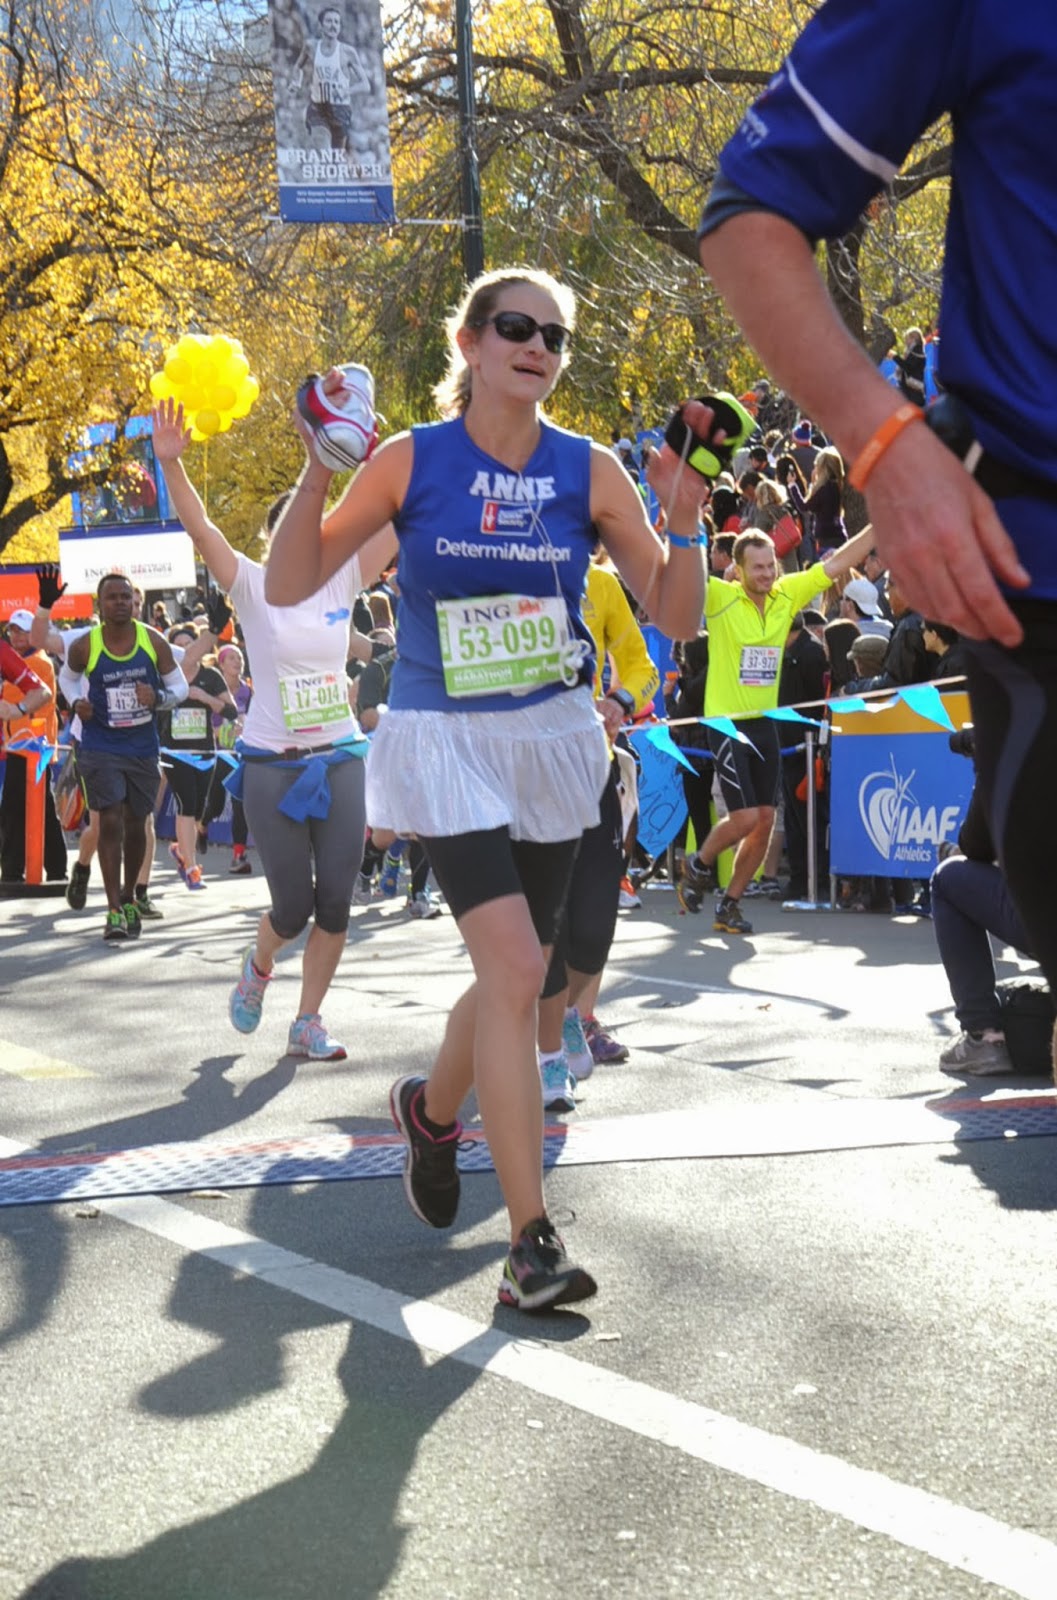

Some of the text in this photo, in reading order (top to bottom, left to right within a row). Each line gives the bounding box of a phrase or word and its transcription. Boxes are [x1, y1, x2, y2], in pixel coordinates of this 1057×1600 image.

[286, 148, 347, 163] FRANK
[302, 163, 383, 179] SHORTER
[469, 470, 556, 502] ANNE
[436, 537, 571, 562] DetermiNation
[463, 604, 511, 624] ING
[458, 616, 556, 661] 53-099
[295, 677, 321, 689] ING
[295, 685, 340, 709] 17-014
[896, 806, 960, 845] IAAF
[894, 846, 932, 862] Athletics
